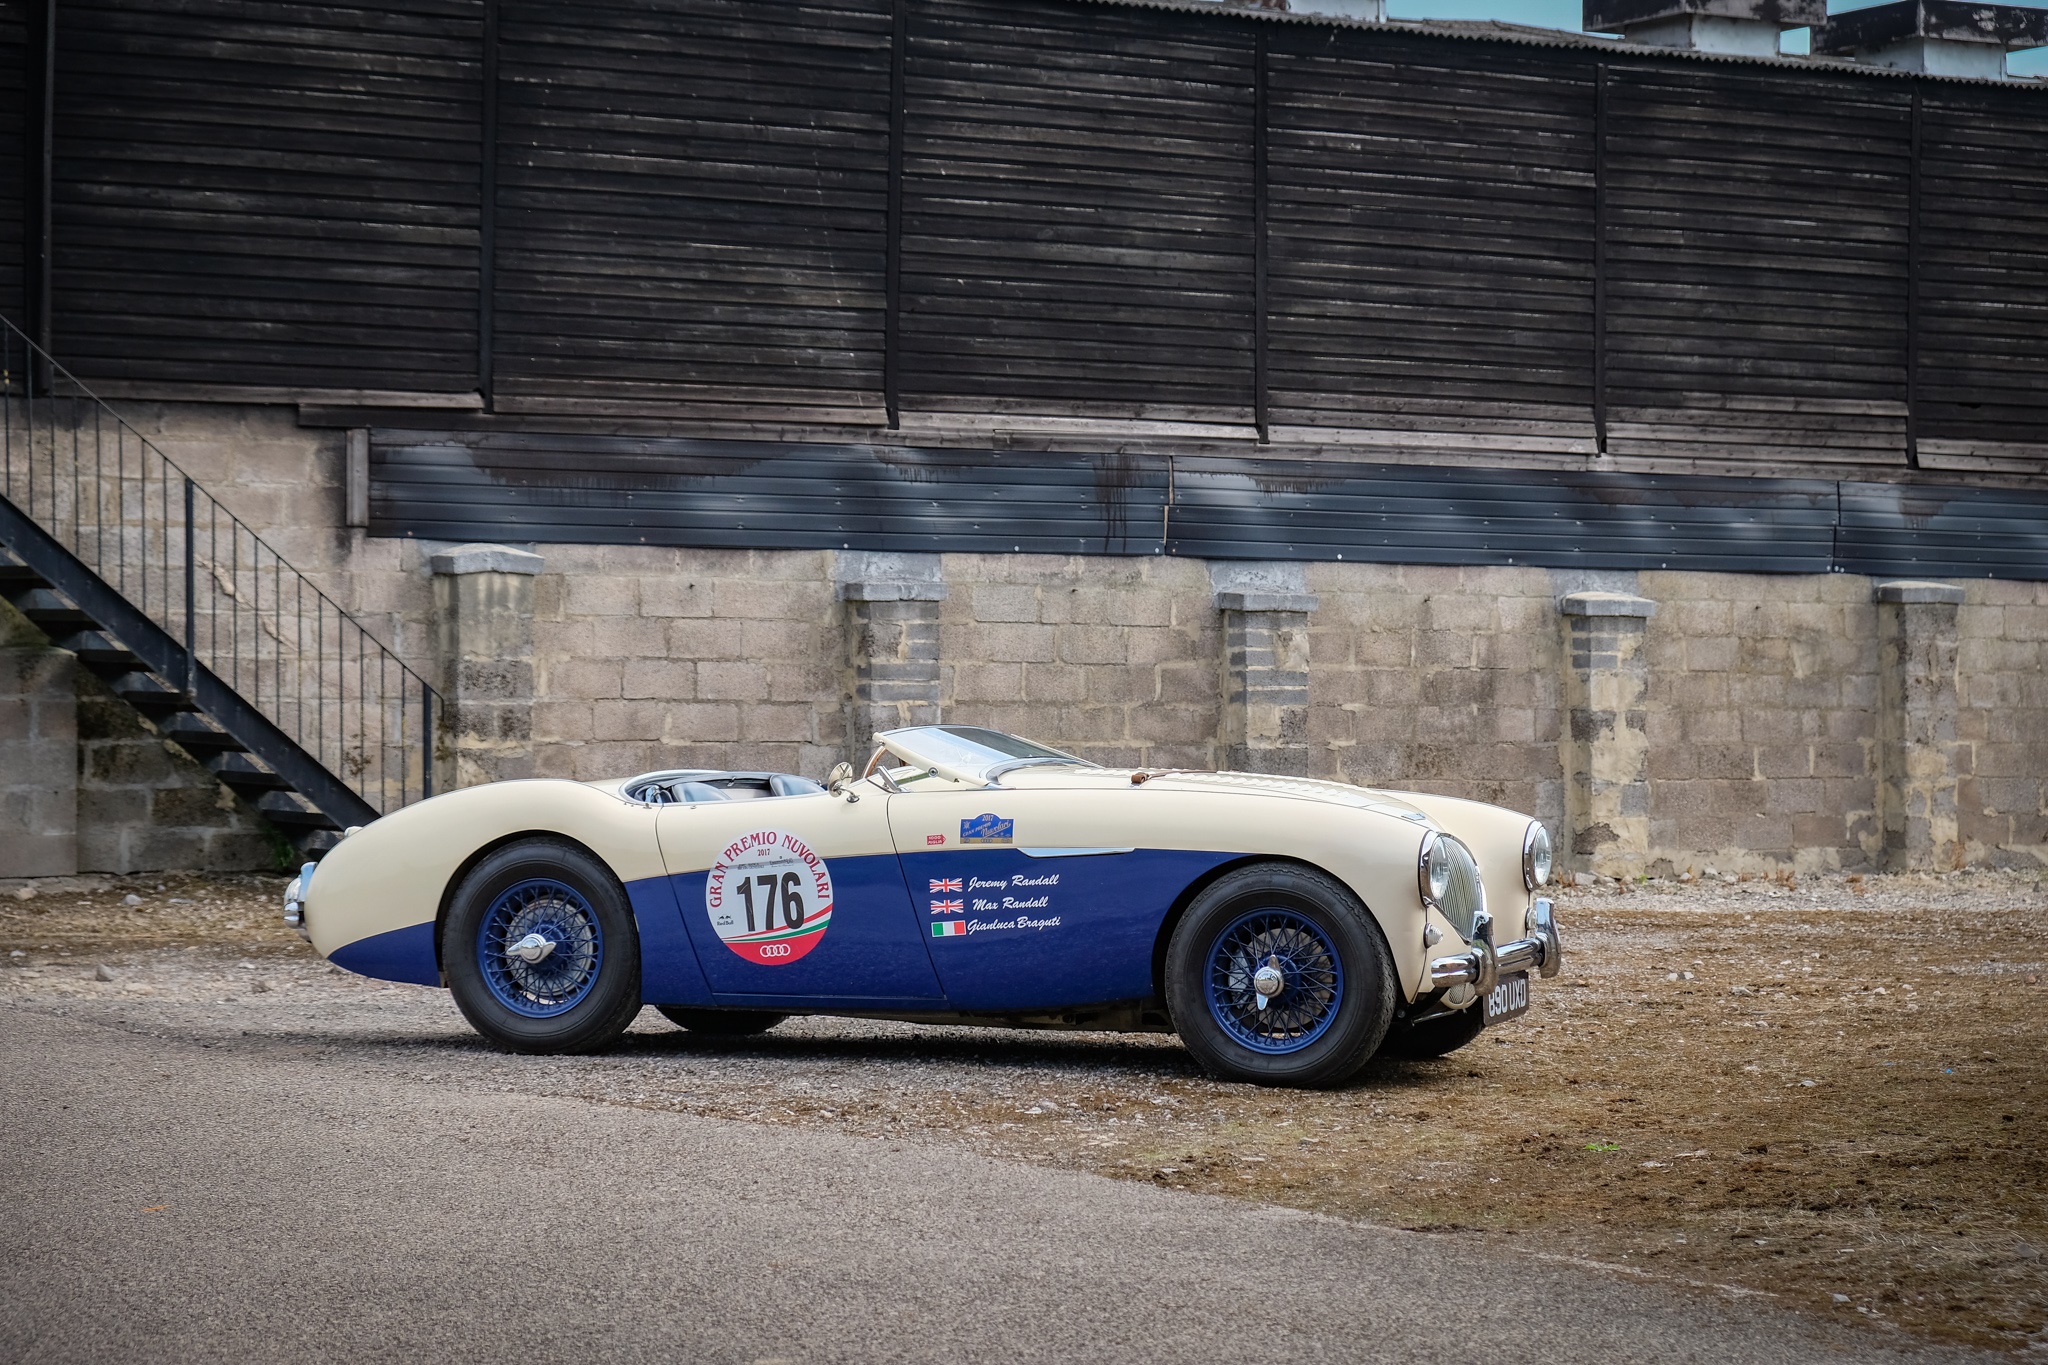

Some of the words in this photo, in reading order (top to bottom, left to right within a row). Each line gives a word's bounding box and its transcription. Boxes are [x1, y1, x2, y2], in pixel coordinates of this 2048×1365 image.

[757, 848, 770, 856] 2017
[709, 861, 729, 908] GRAN
[723, 831, 777, 862] PREMIO
[781, 834, 830, 899] NUVOLARI
[967, 876, 1009, 892] Jeremy
[1011, 874, 1060, 887] Randall
[736, 871, 805, 932] 176
[972, 898, 999, 911] Max
[1002, 896, 1049, 909] Randall
[967, 918, 1016, 935] Gianluca
[1016, 916, 1061, 931] Braguti
